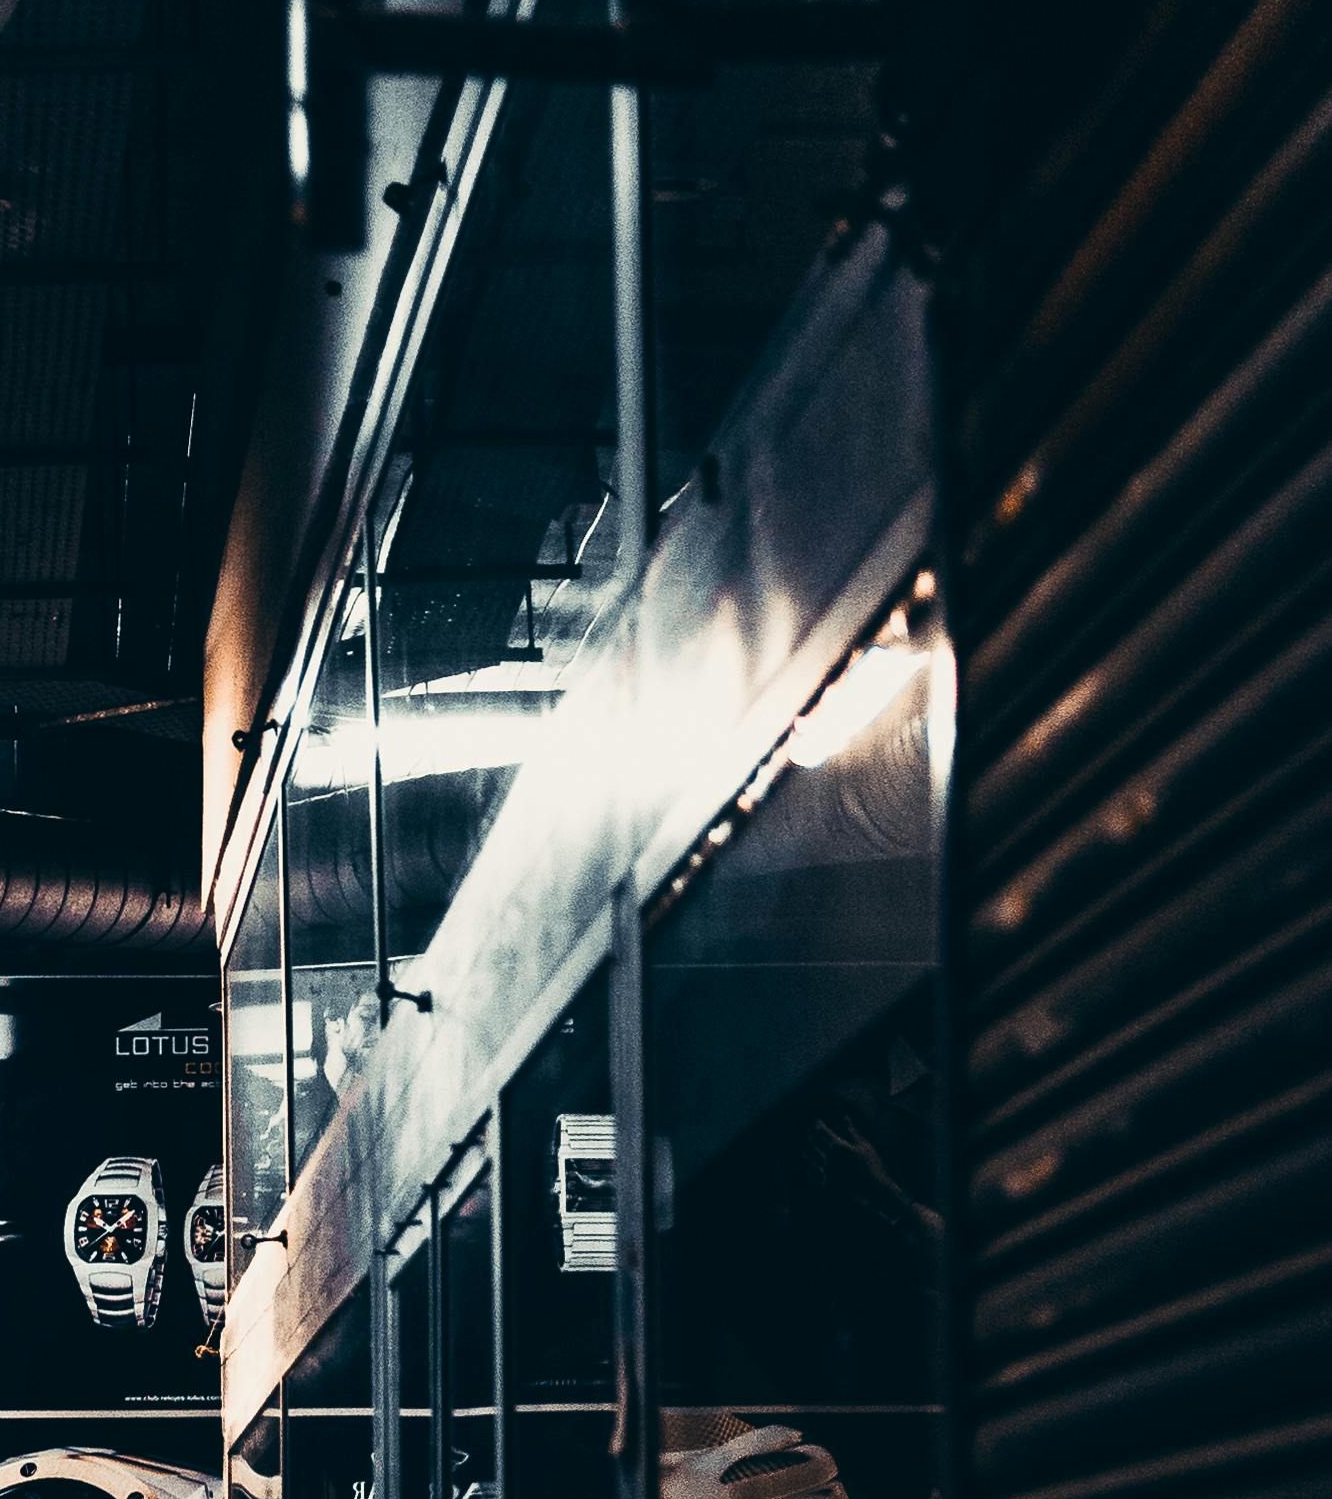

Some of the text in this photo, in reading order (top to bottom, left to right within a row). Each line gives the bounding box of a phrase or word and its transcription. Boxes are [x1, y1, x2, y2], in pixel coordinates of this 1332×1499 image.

[115, 1035, 209, 1055] LOTUS
[115, 1079, 138, 1092] get
[143, 1079, 168, 1089] into
[173, 1078, 196, 1089] the
